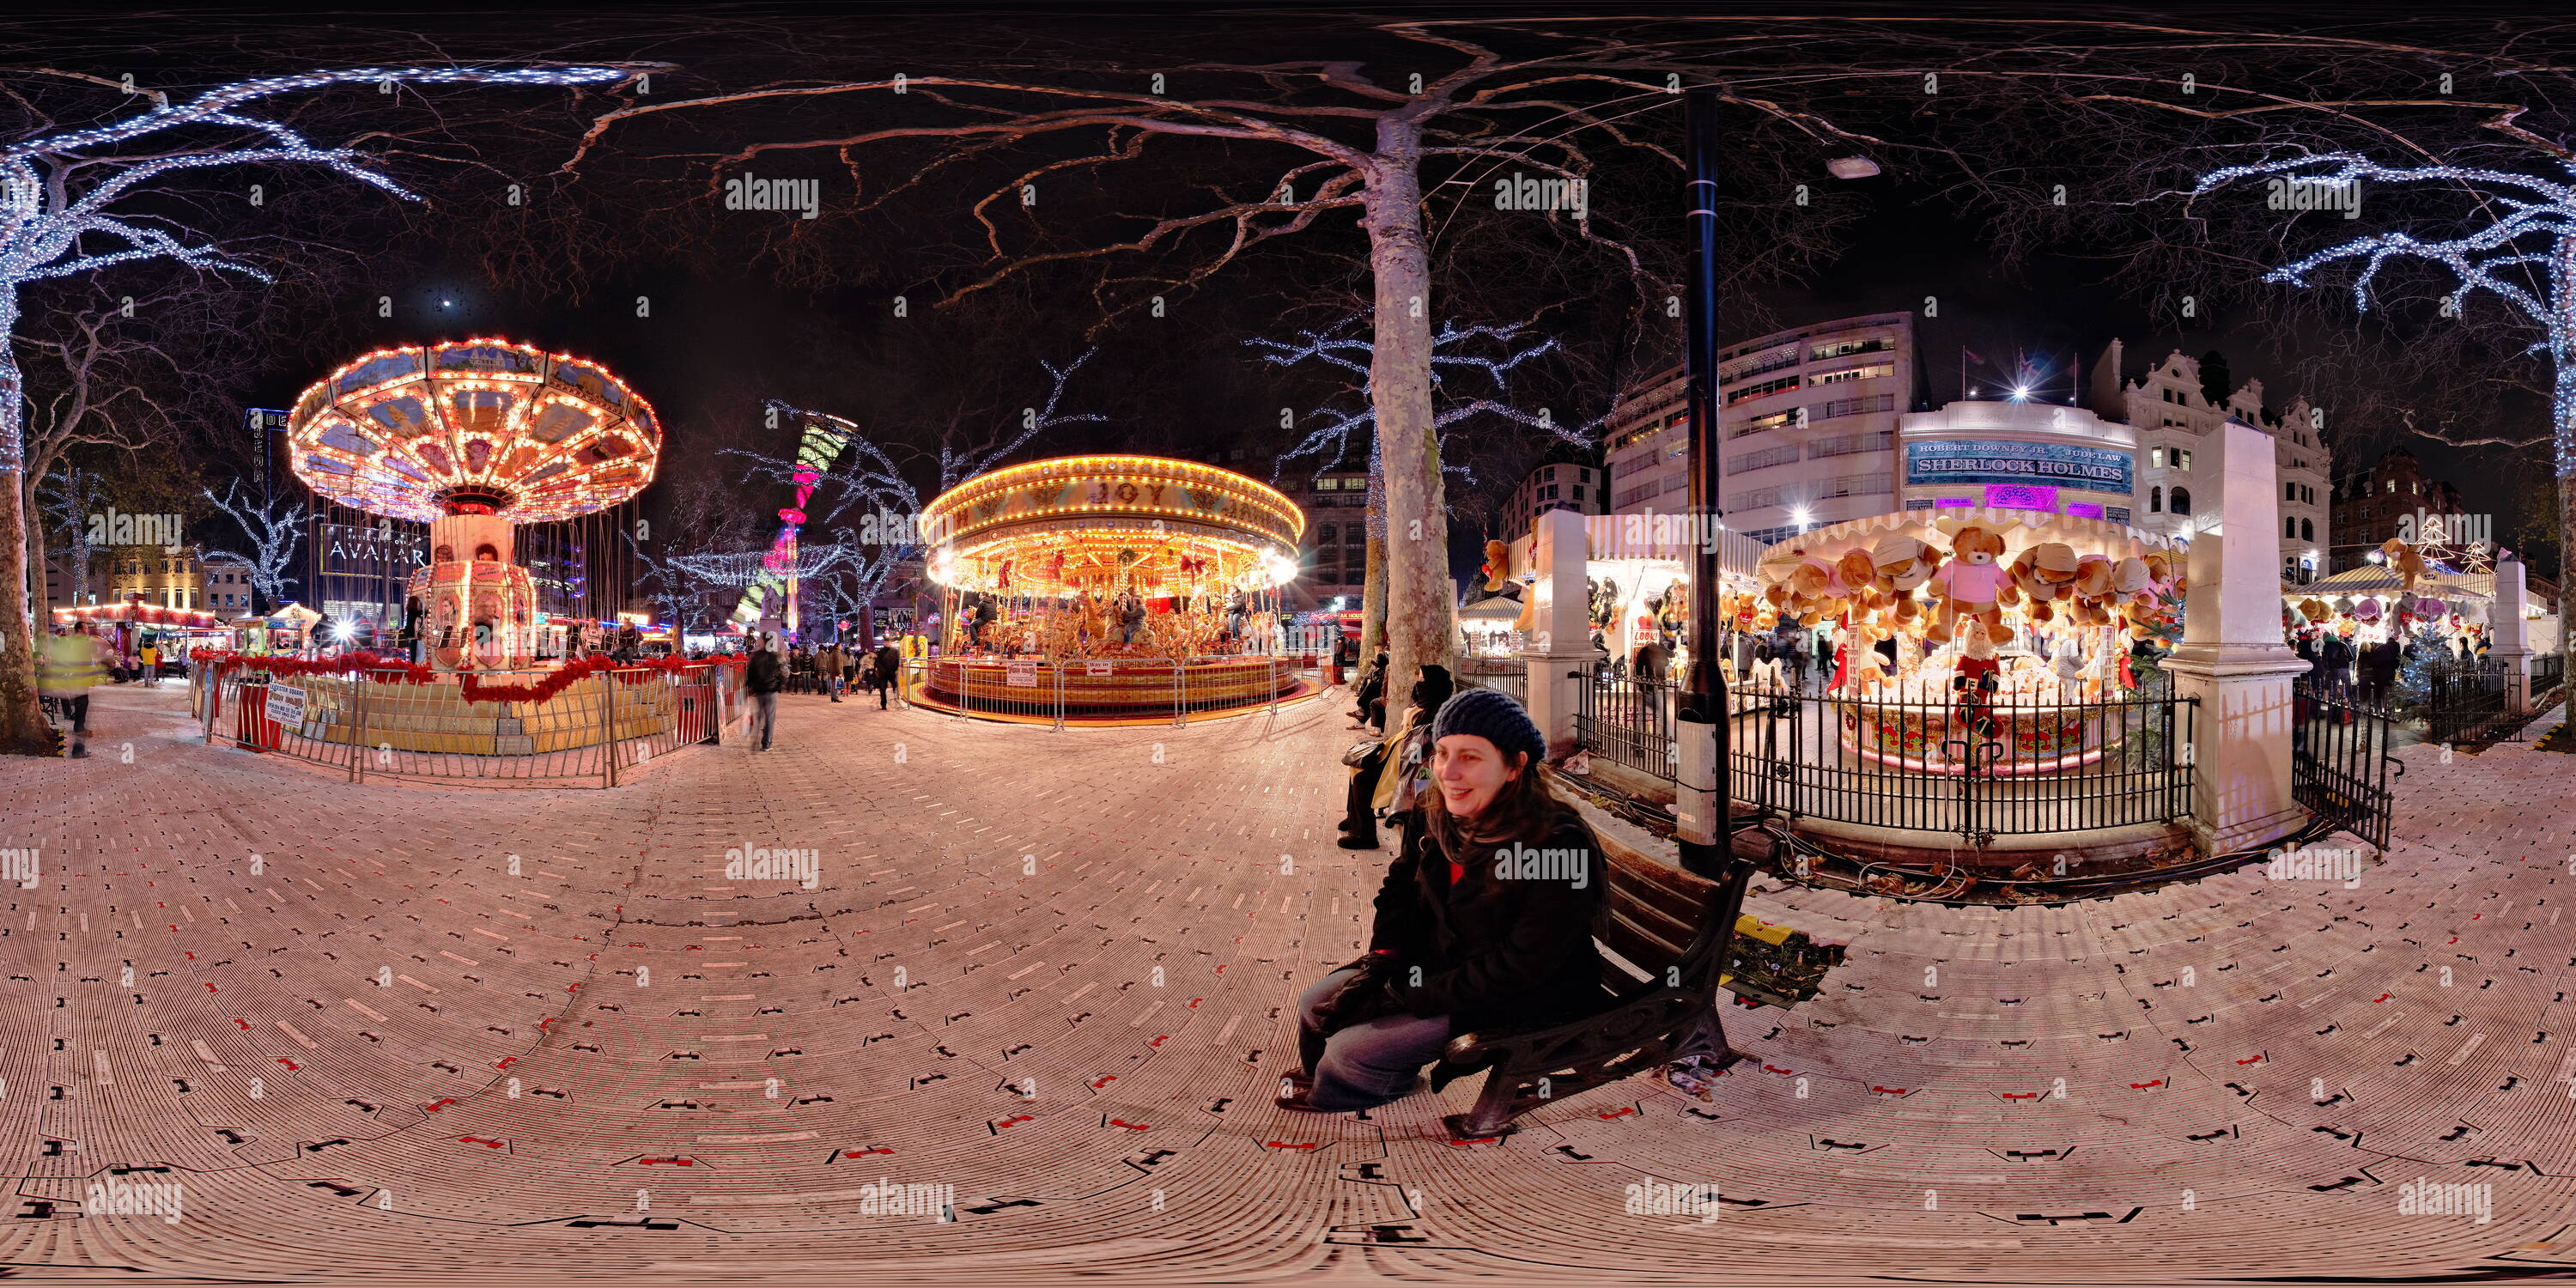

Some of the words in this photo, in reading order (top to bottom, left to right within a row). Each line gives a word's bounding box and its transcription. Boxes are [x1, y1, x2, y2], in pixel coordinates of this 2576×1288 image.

[1919, 444, 1970, 453] ROBERT
[1972, 445, 2028, 454] DOWNEY
[2029, 445, 2049, 455] JR.
[2065, 449, 2096, 459] JUDE
[2098, 453, 2122, 462] LAW
[1918, 459, 2036, 473] SHERLOCK
[2037, 460, 2123, 481] HOLMES
[1087, 483, 1165, 505] JOY
[1635, 632, 1658, 641] LOOK!
[270, 683, 289, 692] LEICESTER
